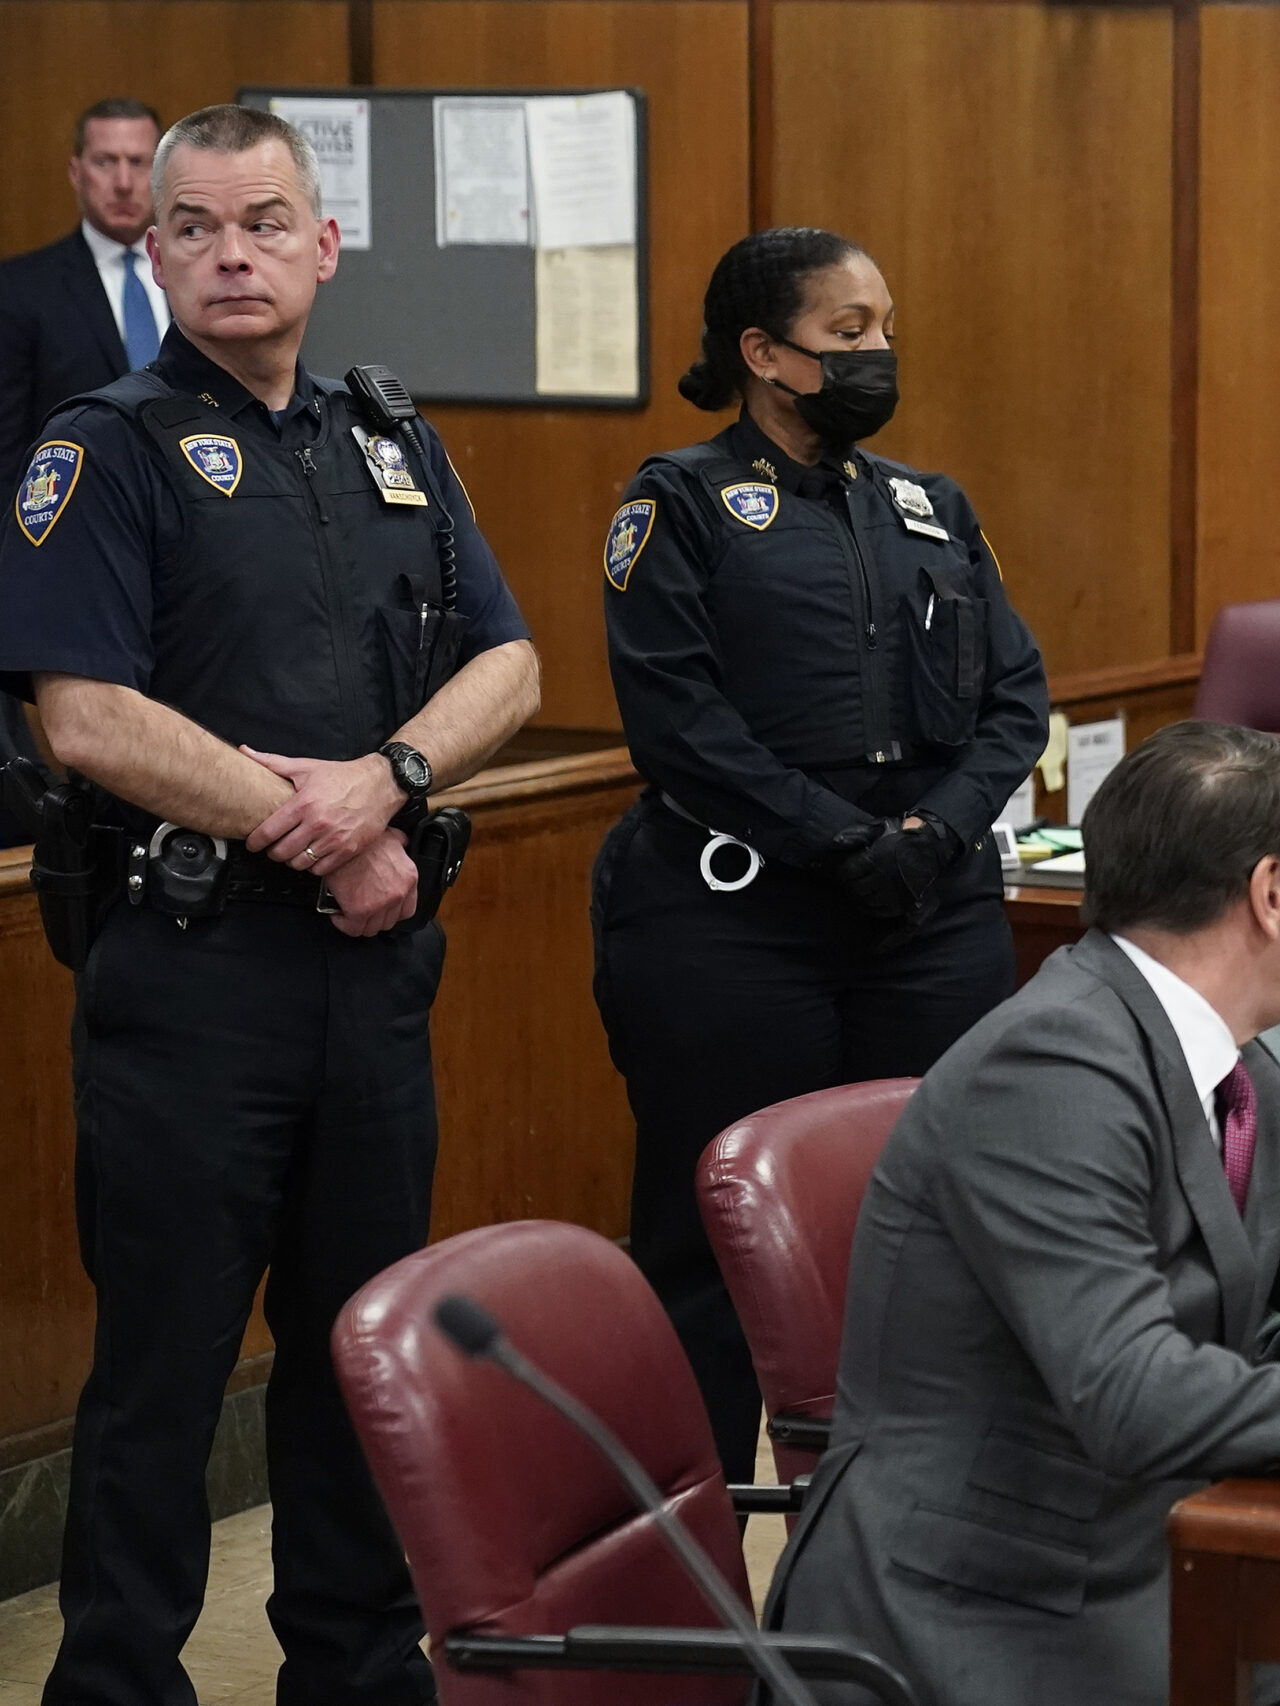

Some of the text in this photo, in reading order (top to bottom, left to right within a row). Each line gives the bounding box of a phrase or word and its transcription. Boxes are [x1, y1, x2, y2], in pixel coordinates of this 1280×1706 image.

[52, 446, 77, 463] STATE
[630, 504, 651, 516] STATE
[24, 511, 54, 526] COURTS
[611, 557, 632, 577] COURTS
